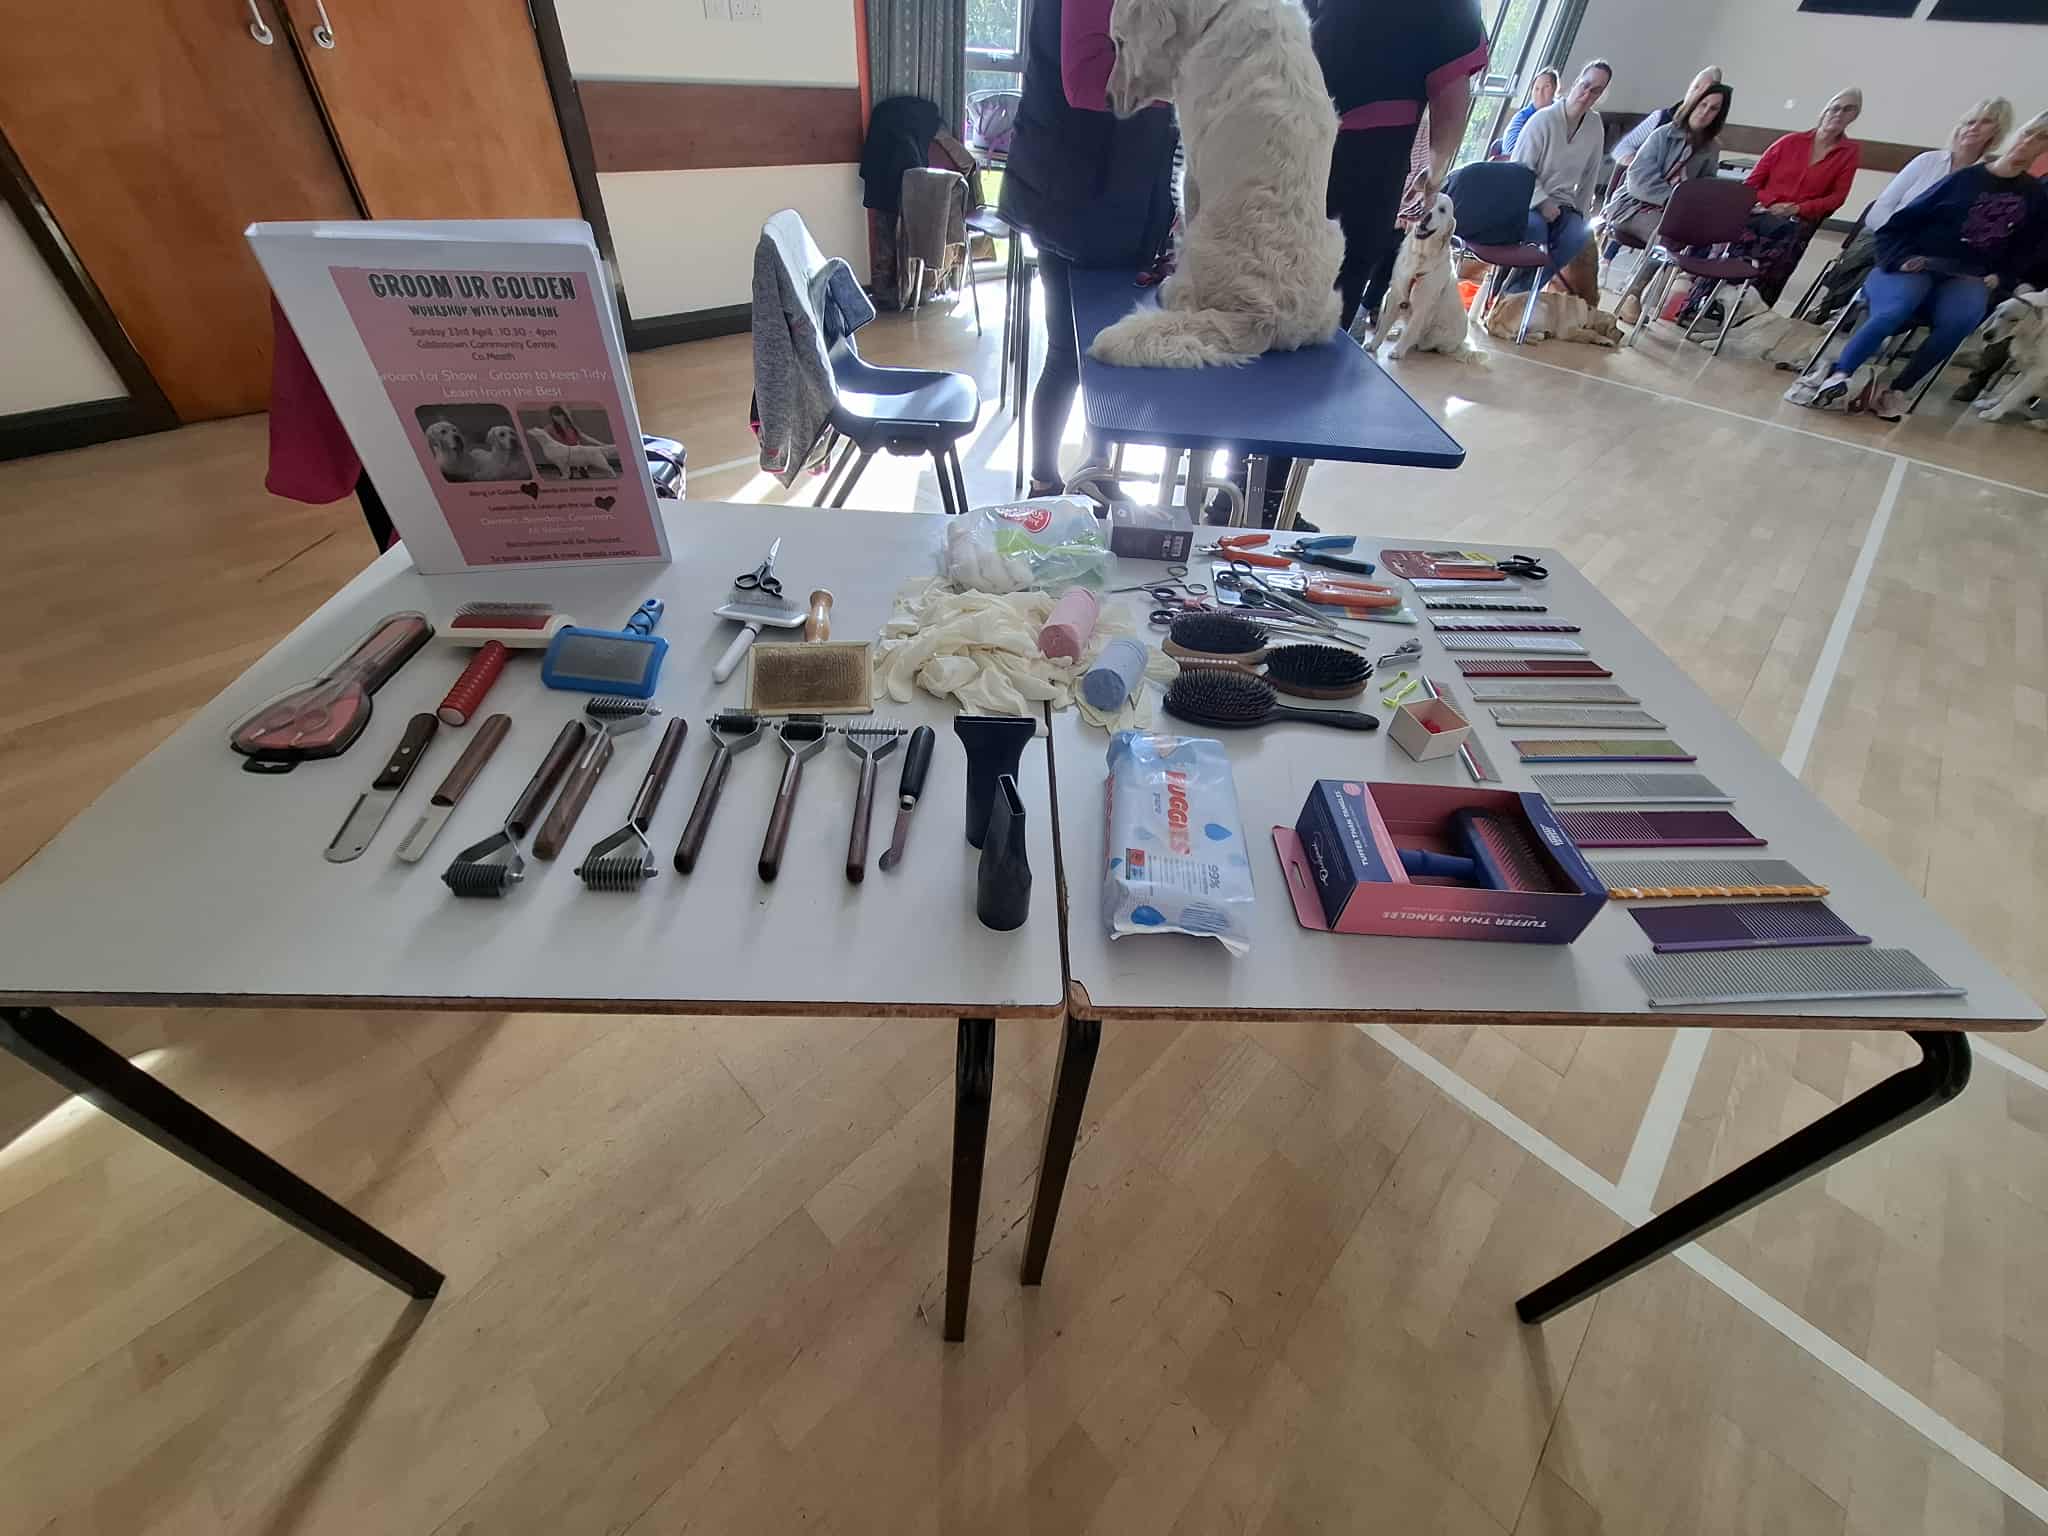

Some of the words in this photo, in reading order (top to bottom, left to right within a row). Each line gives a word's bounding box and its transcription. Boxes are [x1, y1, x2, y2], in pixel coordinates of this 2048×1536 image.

[368, 273, 453, 298] GROOM
[455, 275, 489, 299] UR
[492, 276, 576, 300] GOLDEN
[408, 305, 468, 317] WORKSHOP
[470, 305, 499, 317] WITH
[471, 340, 524, 350] Community
[440, 369, 478, 381] Show
[488, 369, 532, 381] Groom
[535, 370, 548, 381] to
[480, 385, 512, 398] from
[1449, 914, 1491, 925] THAN
[1495, 917, 1548, 928] TUFFER
